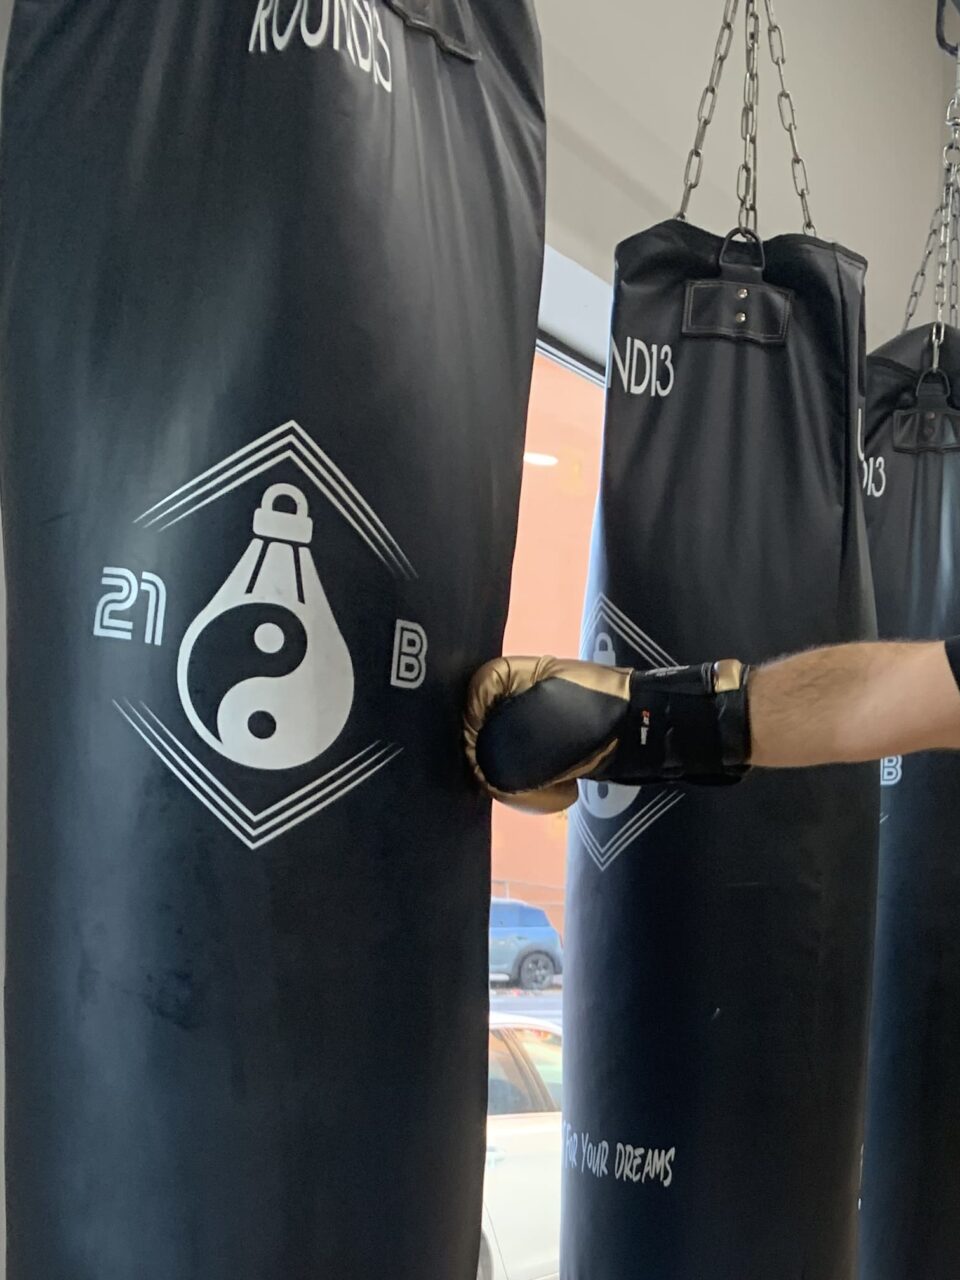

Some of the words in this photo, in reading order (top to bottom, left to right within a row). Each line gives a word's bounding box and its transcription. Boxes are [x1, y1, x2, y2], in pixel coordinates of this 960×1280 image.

[93, 566, 167, 646] 21
[391, 619, 428, 688] B
[581, 1131, 609, 1178] YOUR
[615, 1142, 675, 1187] DREAMS
